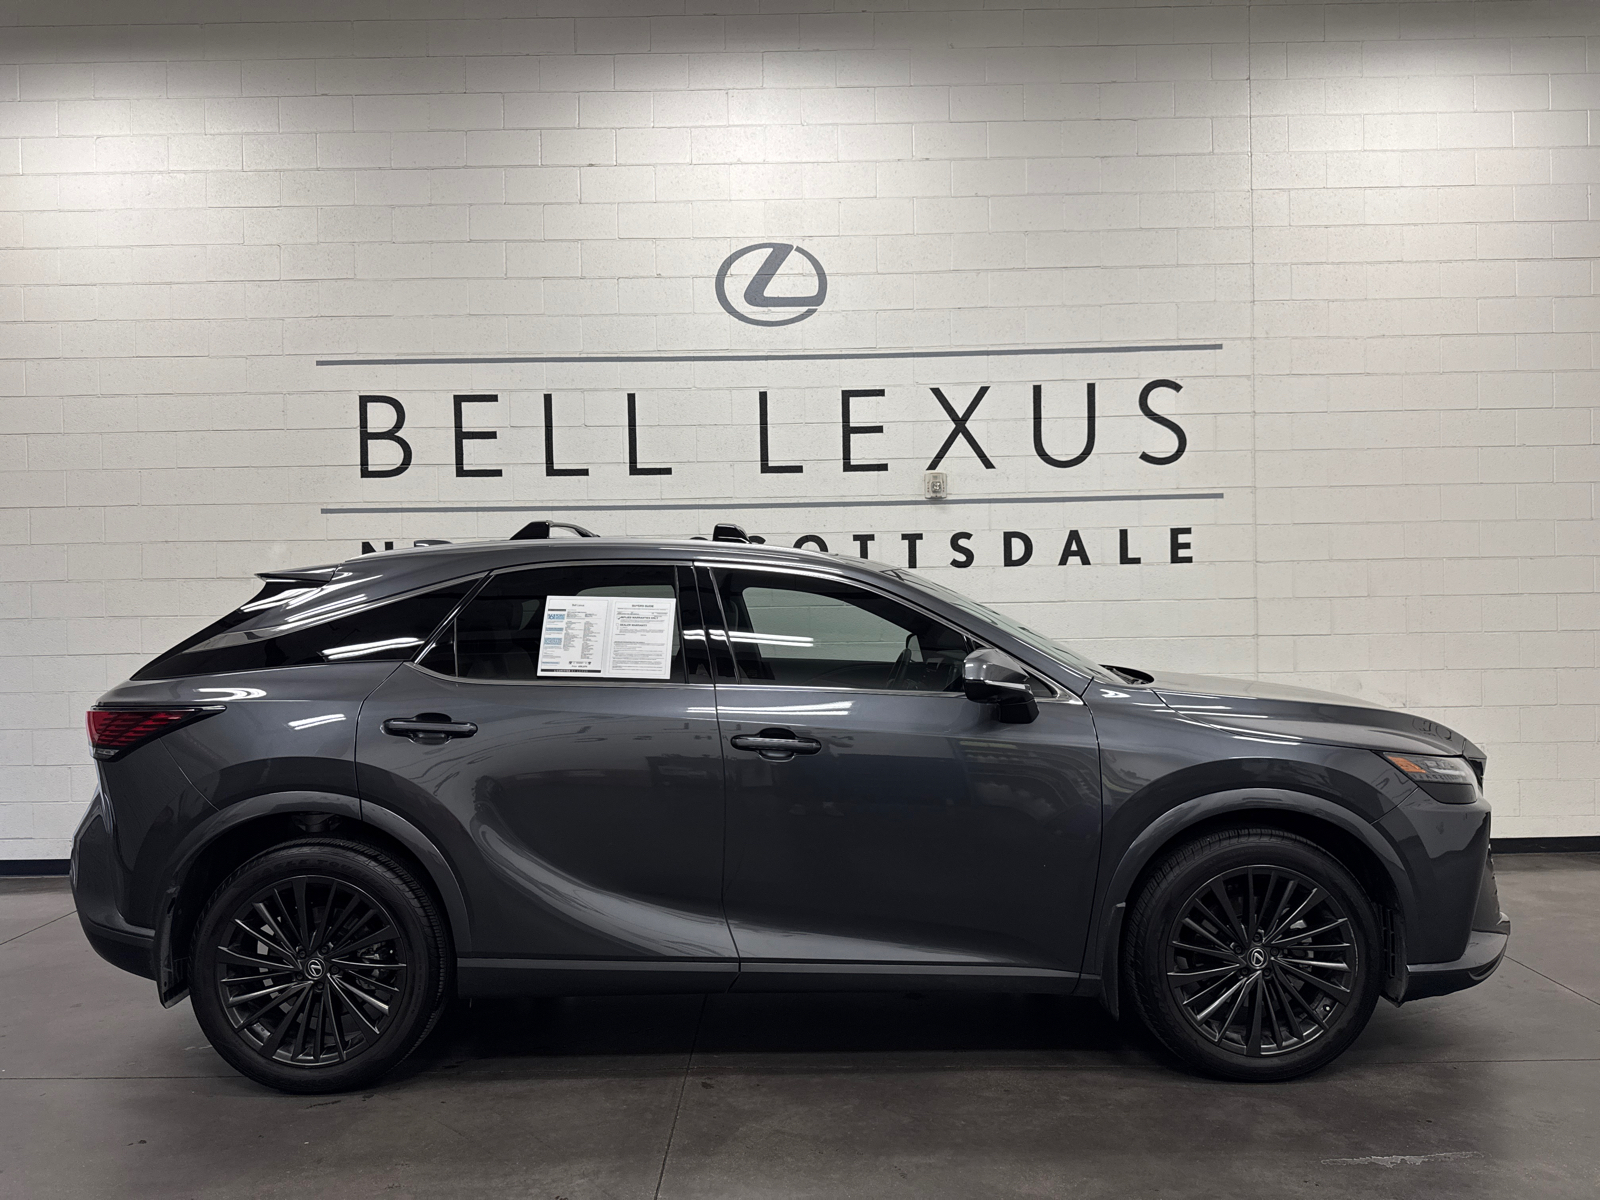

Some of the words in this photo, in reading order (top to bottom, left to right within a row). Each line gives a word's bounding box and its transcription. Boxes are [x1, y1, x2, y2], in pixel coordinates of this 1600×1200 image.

[358, 393, 673, 479] BELL
[758, 378, 1187, 474] LEXUS
[689, 527, 1193, 569] TTSDALE
